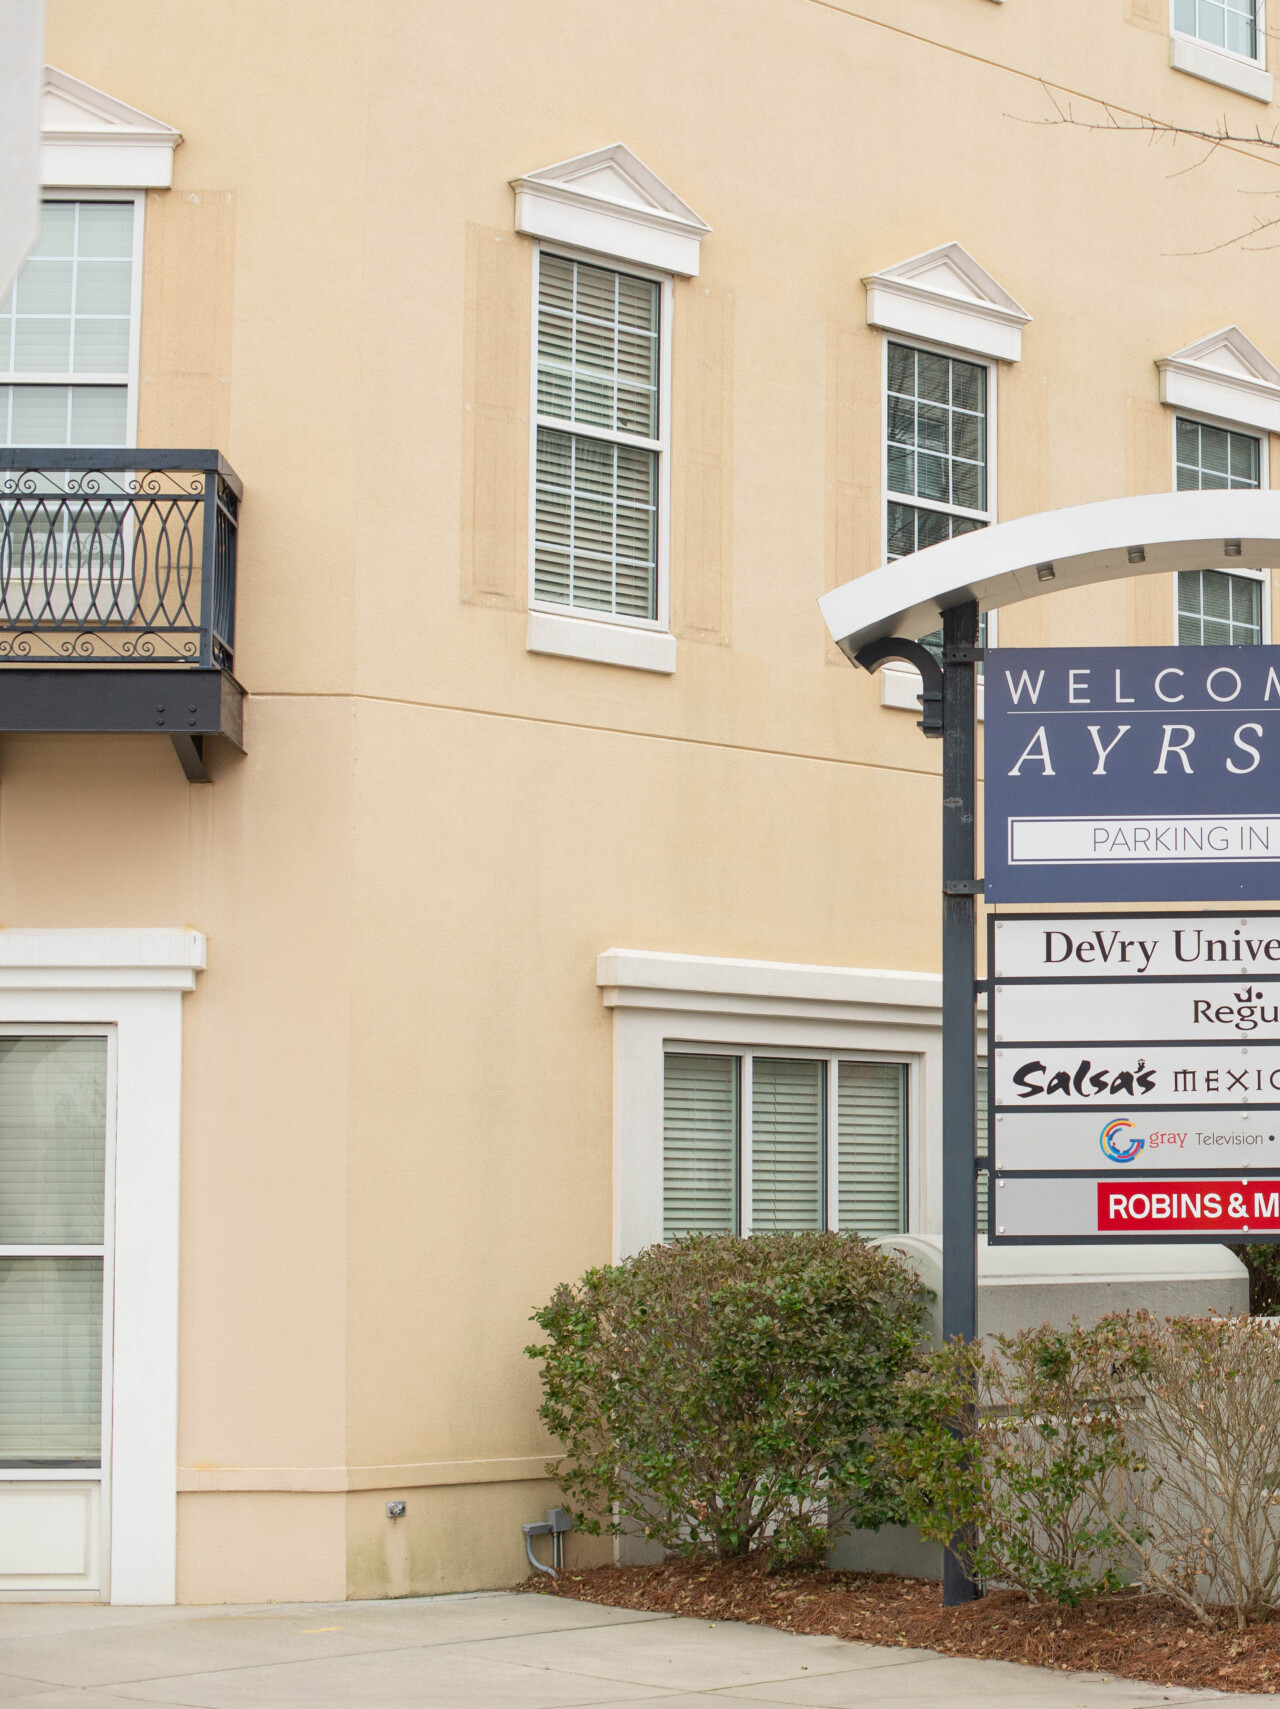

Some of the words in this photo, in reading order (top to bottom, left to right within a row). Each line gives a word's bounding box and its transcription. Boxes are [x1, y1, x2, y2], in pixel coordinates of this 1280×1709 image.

[1094, 826, 1228, 852] PARKING
[1241, 826, 1269, 850] IN
[1043, 931, 1159, 973] DeVry
[1013, 1058, 1157, 1098] Salsa's
[1150, 1132, 1187, 1148] gray
[1195, 1132, 1263, 1145] Television
[1110, 1193, 1222, 1218] ROBINS
[1228, 1193, 1249, 1217] &
